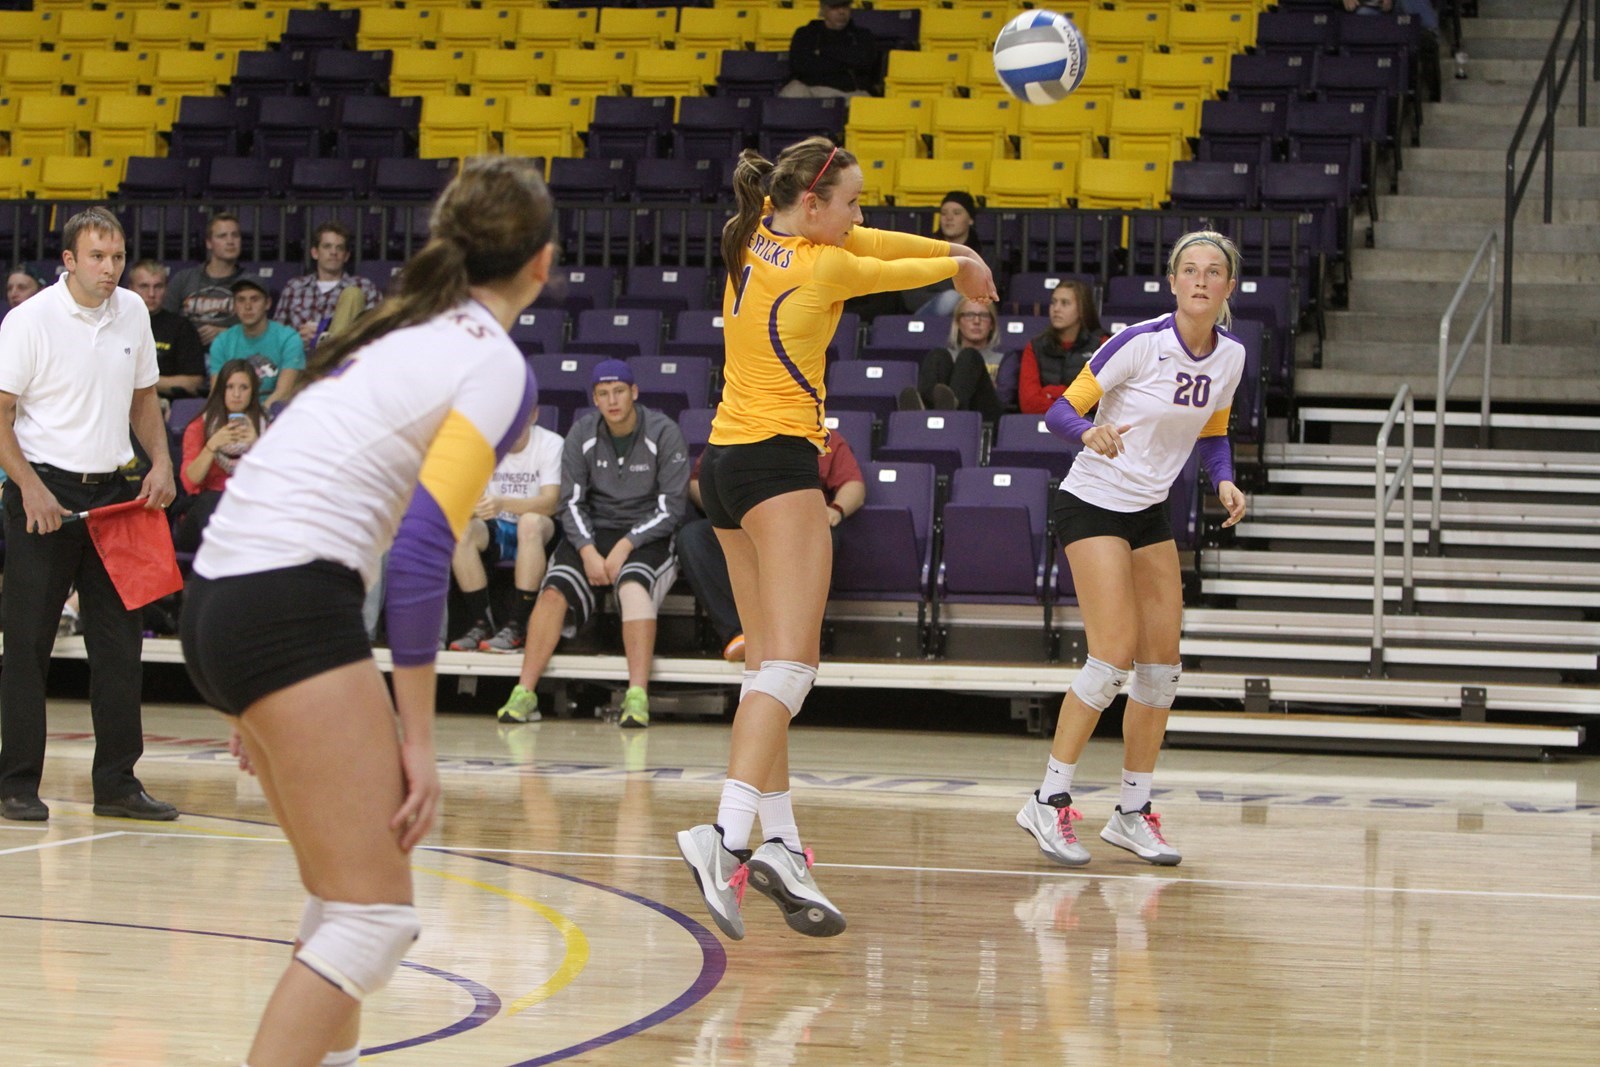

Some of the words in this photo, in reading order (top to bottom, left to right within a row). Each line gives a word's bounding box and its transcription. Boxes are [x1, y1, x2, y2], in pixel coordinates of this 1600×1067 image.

[1063, 25, 1079, 77] molten
[1173, 371, 1212, 408] 20
[500, 483, 528, 495] STATE
